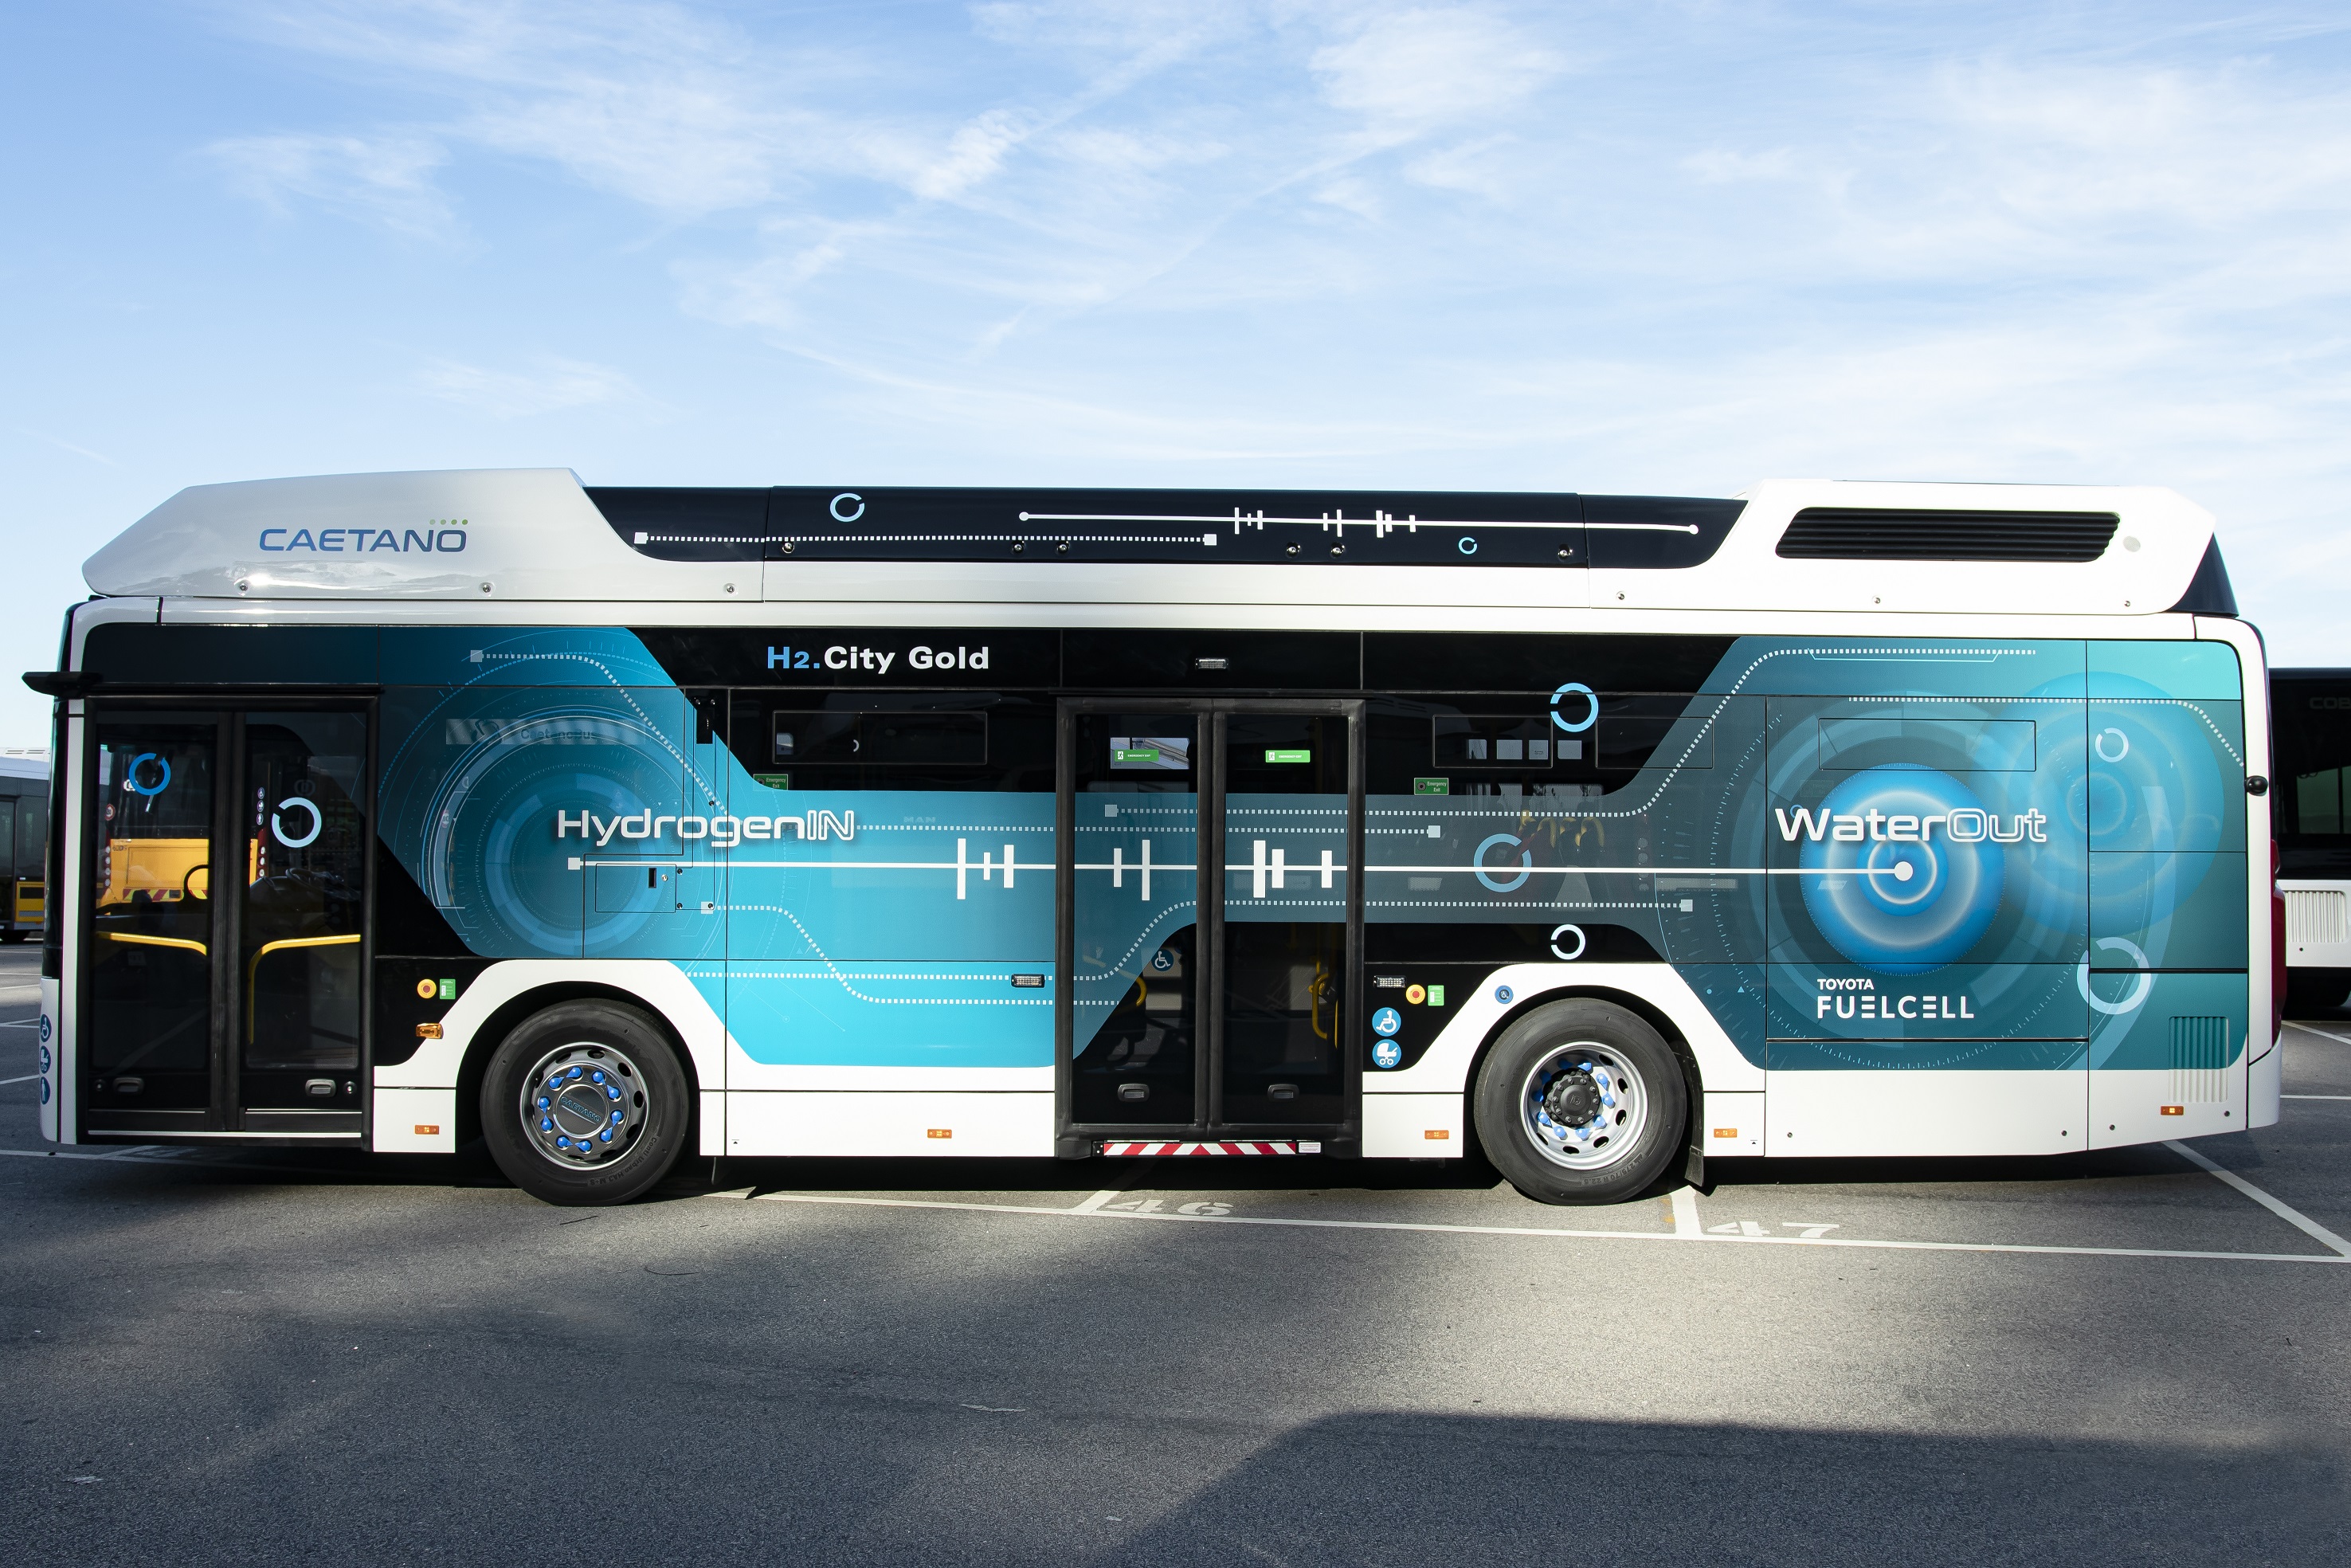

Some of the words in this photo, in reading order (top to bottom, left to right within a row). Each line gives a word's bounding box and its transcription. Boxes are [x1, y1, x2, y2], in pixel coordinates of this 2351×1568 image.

[259, 528, 467, 552] CAETANO
[908, 645, 989, 669] Gold
[558, 808, 855, 847] HydrogenIN
[1775, 808, 2047, 843] WaterOut
[1817, 978, 1875, 990] TOYOTA
[560, 1096, 601, 1122] CAETANO
[643, 1137, 657, 1156] Conti
[624, 1155, 645, 1173] Urban
[1610, 1163, 1635, 1179] 275/70
[609, 1171, 624, 1182] HA3
[1106, 1200, 1233, 1216] 46
[1707, 1221, 1840, 1238] 47
